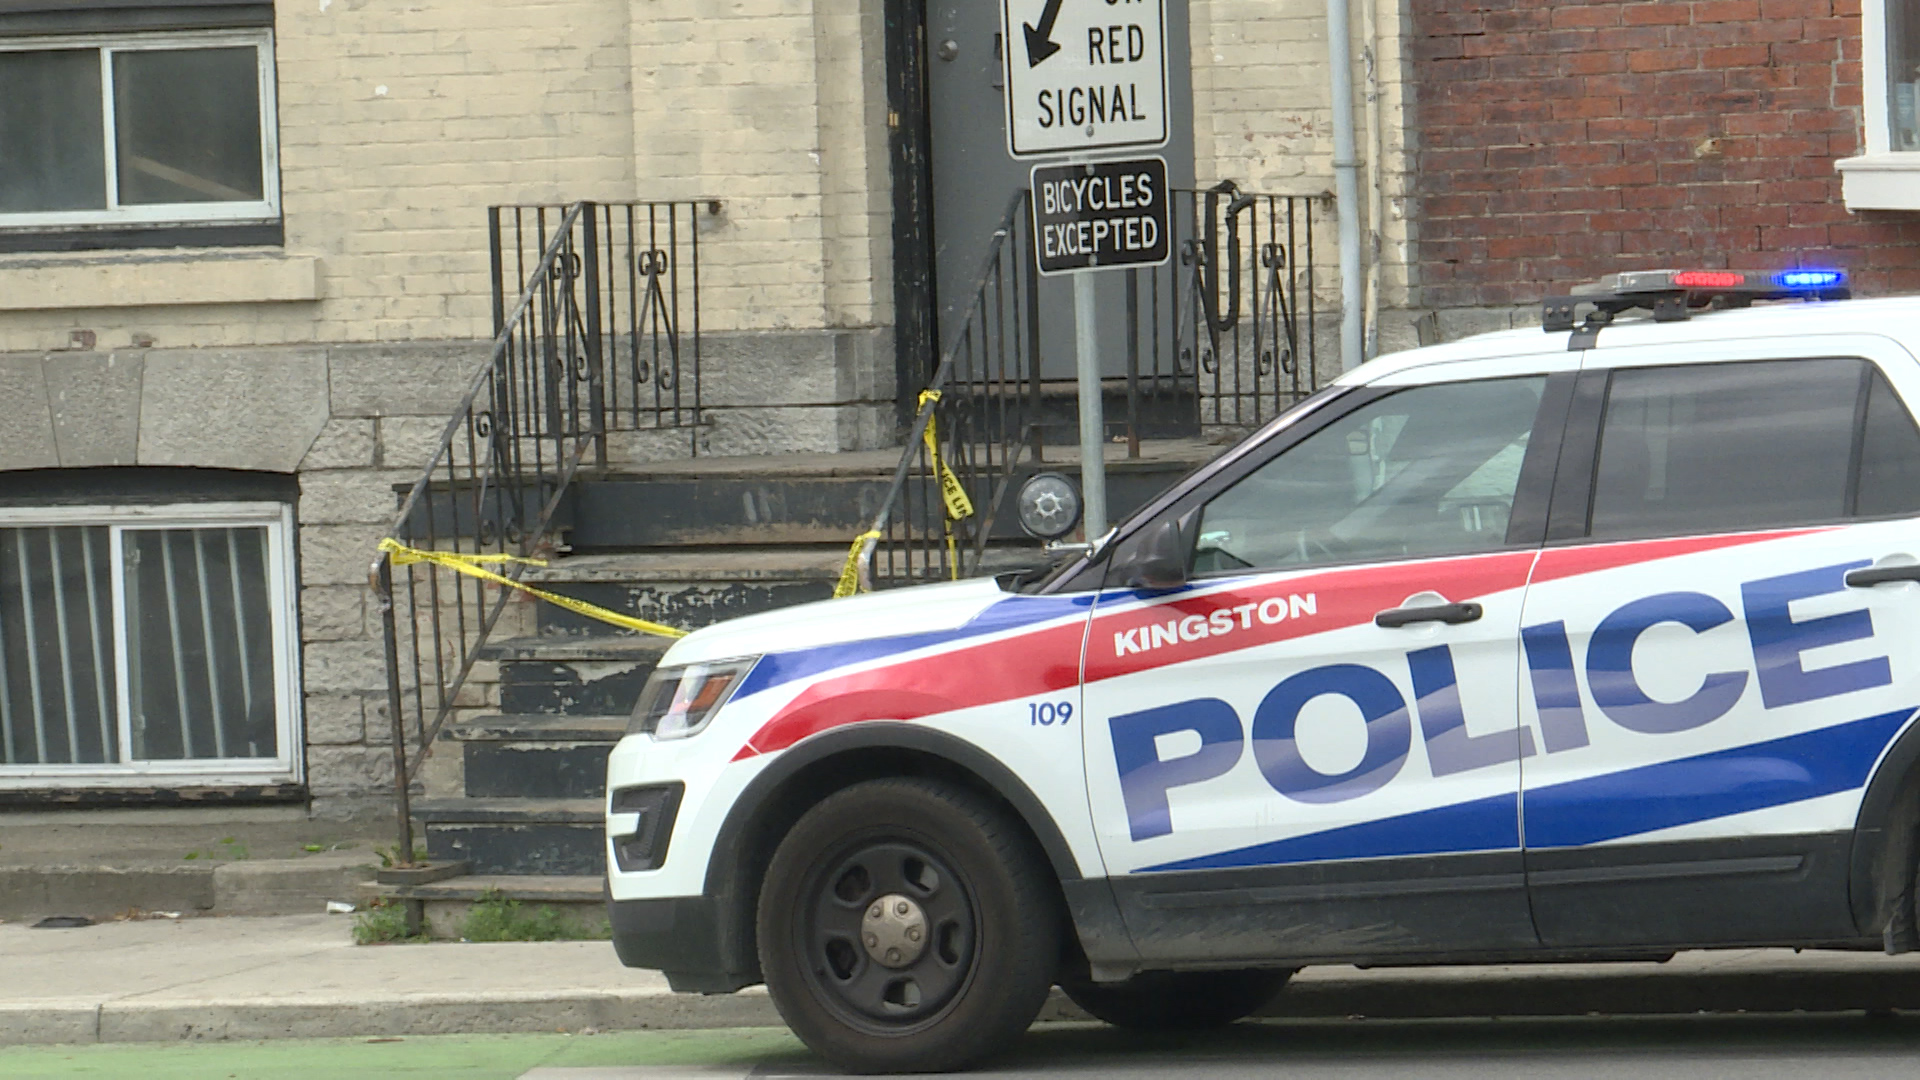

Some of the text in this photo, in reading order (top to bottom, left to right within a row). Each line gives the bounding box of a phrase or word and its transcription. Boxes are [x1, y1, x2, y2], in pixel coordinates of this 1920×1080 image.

[1088, 24, 1144, 65] RED
[1037, 83, 1146, 128] SIGNAL
[1043, 173, 1154, 214] BICYCLES
[1044, 216, 1158, 258] EXCEPTED
[1114, 593, 1317, 657] KINGSTON
[1029, 702, 1073, 726] 109
[1108, 559, 1892, 842] POLICE
